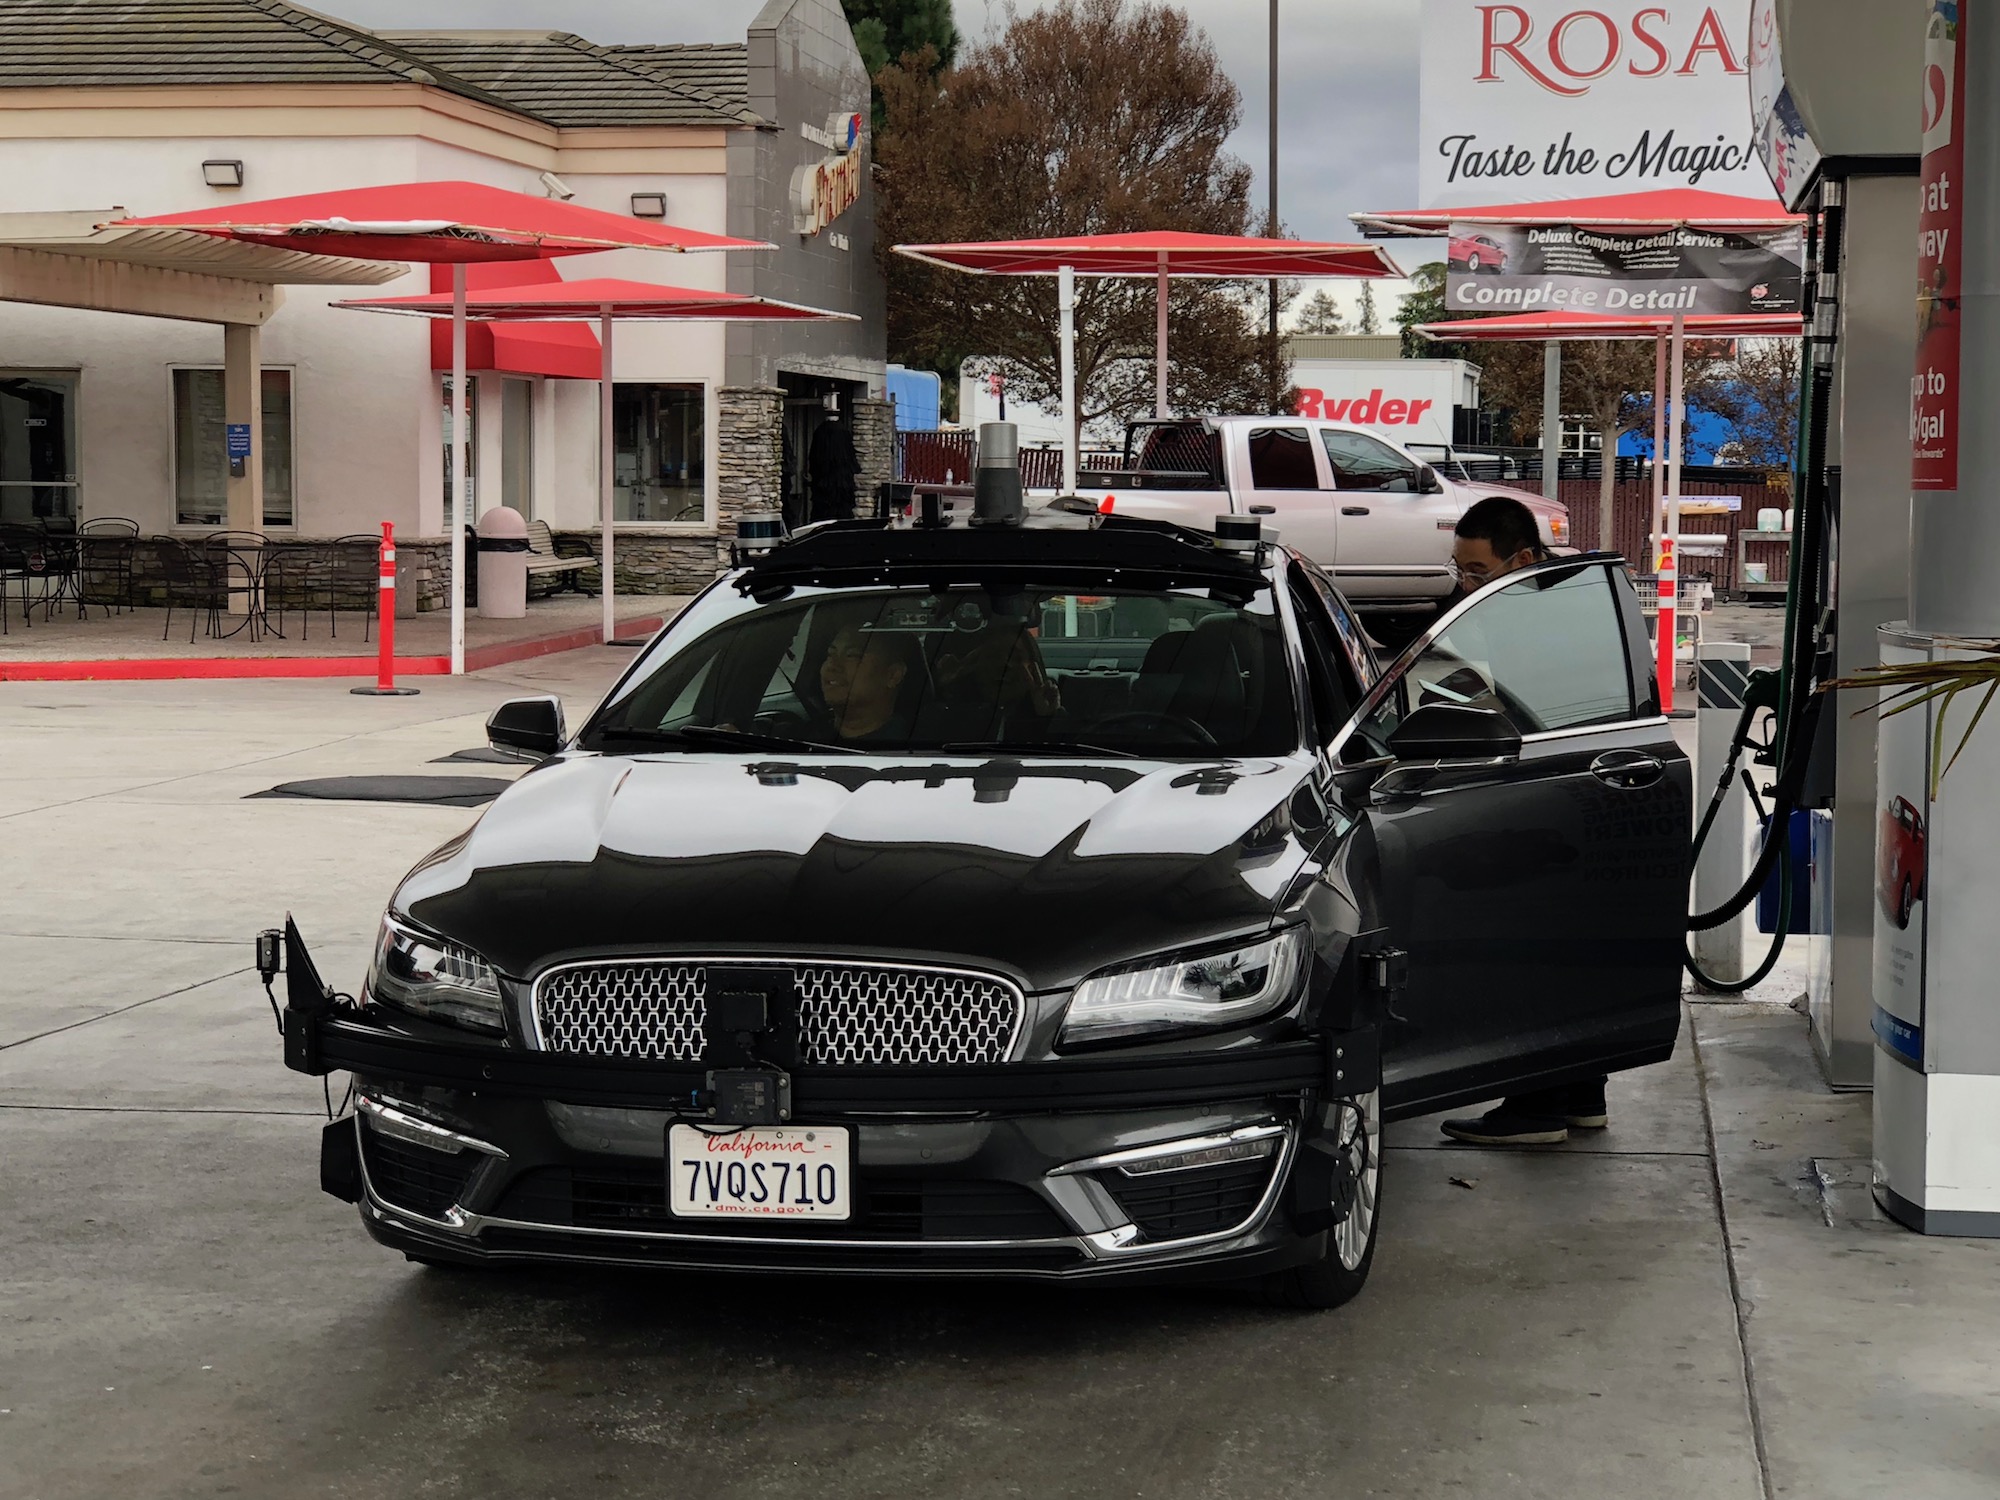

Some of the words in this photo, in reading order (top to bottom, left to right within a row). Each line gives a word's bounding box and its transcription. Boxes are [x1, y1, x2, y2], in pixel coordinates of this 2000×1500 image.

[1473, 5, 1748, 97] ROSA
[1439, 134, 1535, 183] Taste
[1542, 132, 1599, 176] the
[1605, 129, 1755, 185] Magic!
[1928, 171, 1950, 212] at
[1528, 229, 1572, 244] Deluxe
[1574, 231, 1633, 252] Complete
[1635, 232, 1676, 250] Detail
[1675, 231, 1724, 248] Service
[1456, 282, 1599, 309] Complete
[1605, 285, 1697, 309] Detail
[1928, 366, 1945, 395] to
[1296, 388, 1432, 425] Ryder
[707, 1132, 815, 1159] California
[683, 1160, 835, 1205] 7VQS710
[715, 1204, 805, 1214] dmv.ca.gov
